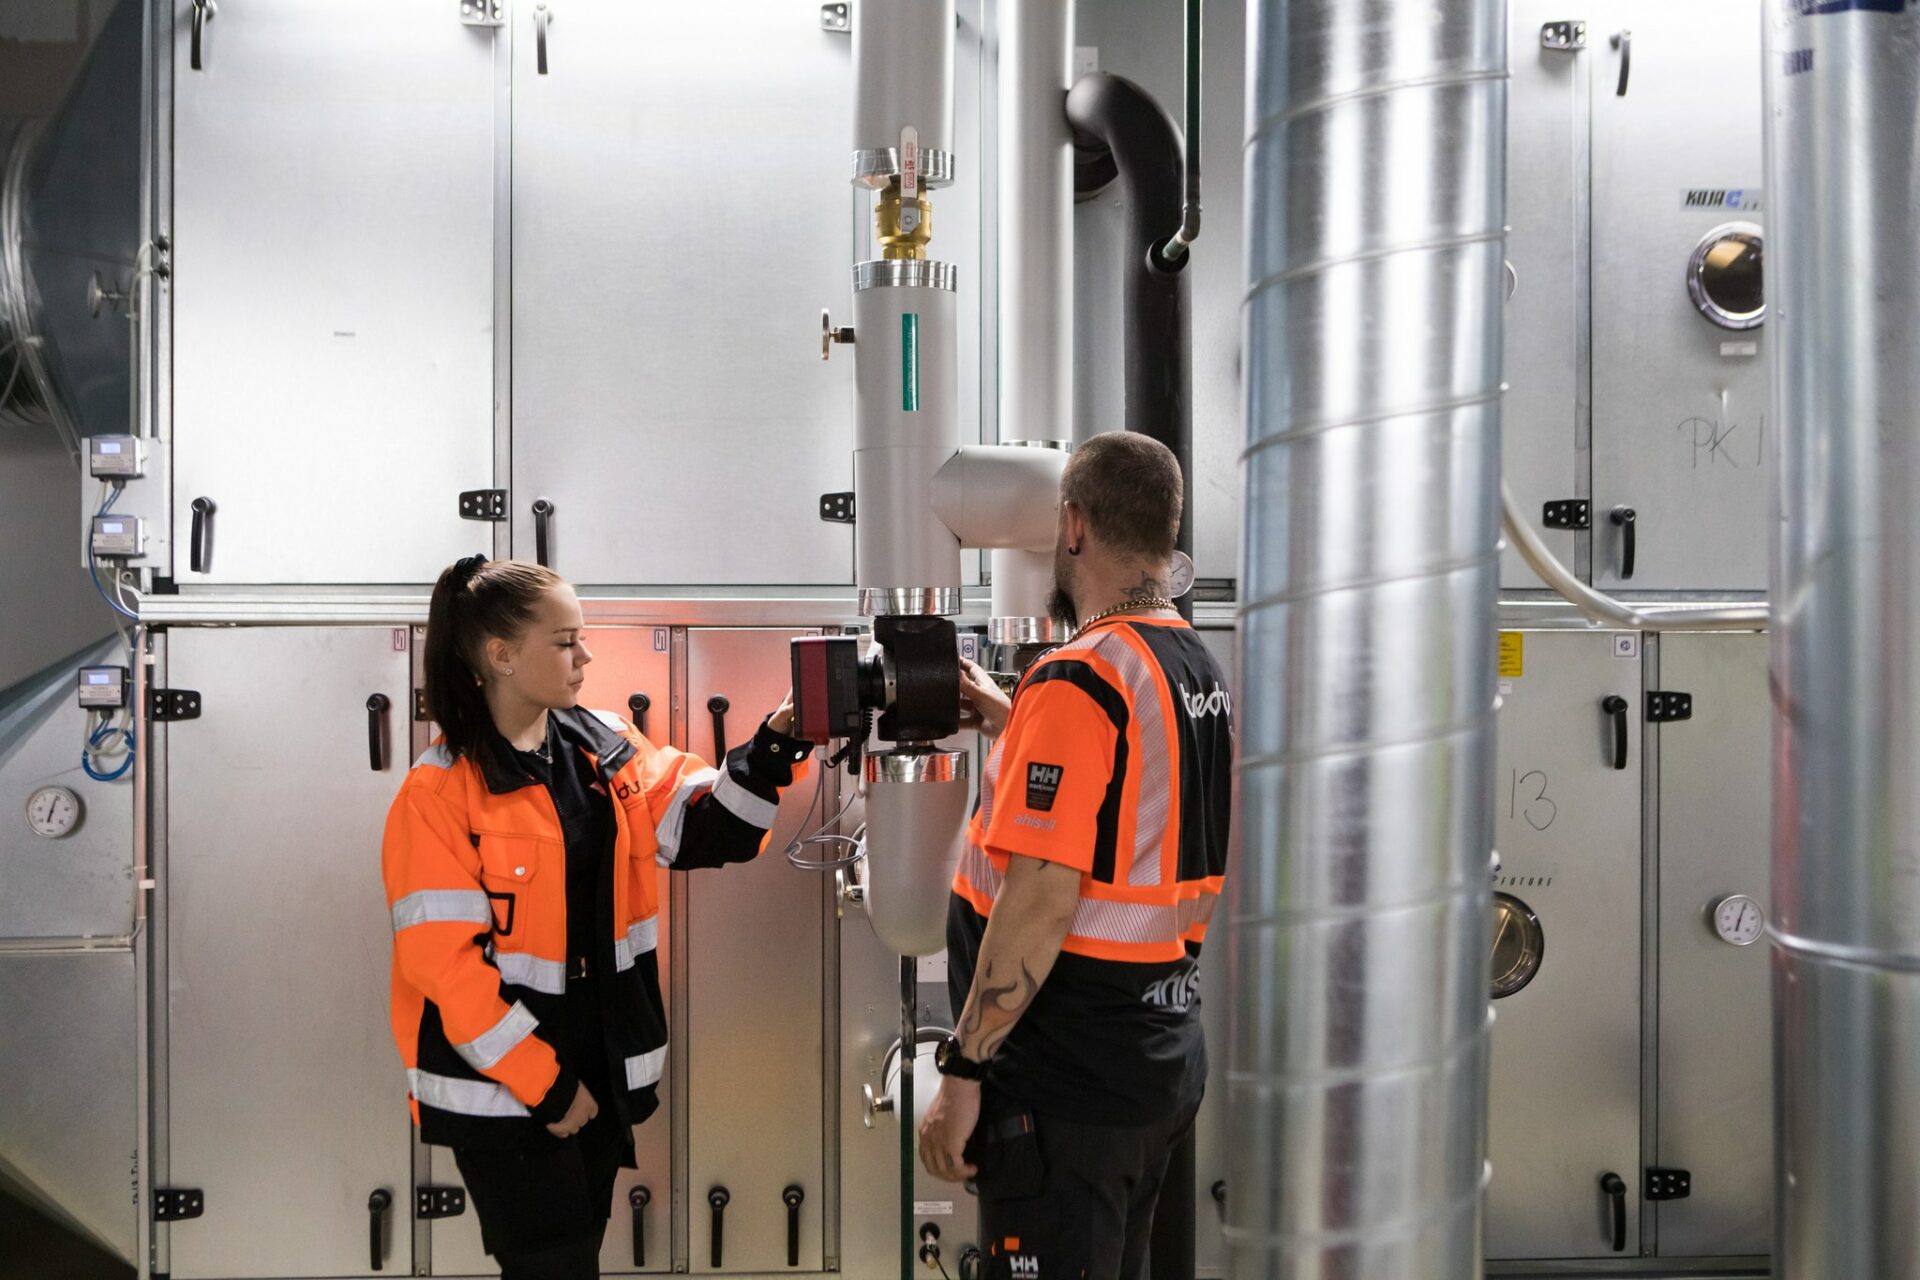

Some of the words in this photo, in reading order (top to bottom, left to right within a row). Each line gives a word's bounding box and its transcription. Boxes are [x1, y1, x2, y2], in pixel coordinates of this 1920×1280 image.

[1677, 416, 1738, 470] PK
[1029, 765, 1060, 785] HH
[1510, 768, 1557, 831] 13
[1010, 1255, 1039, 1272] HH
